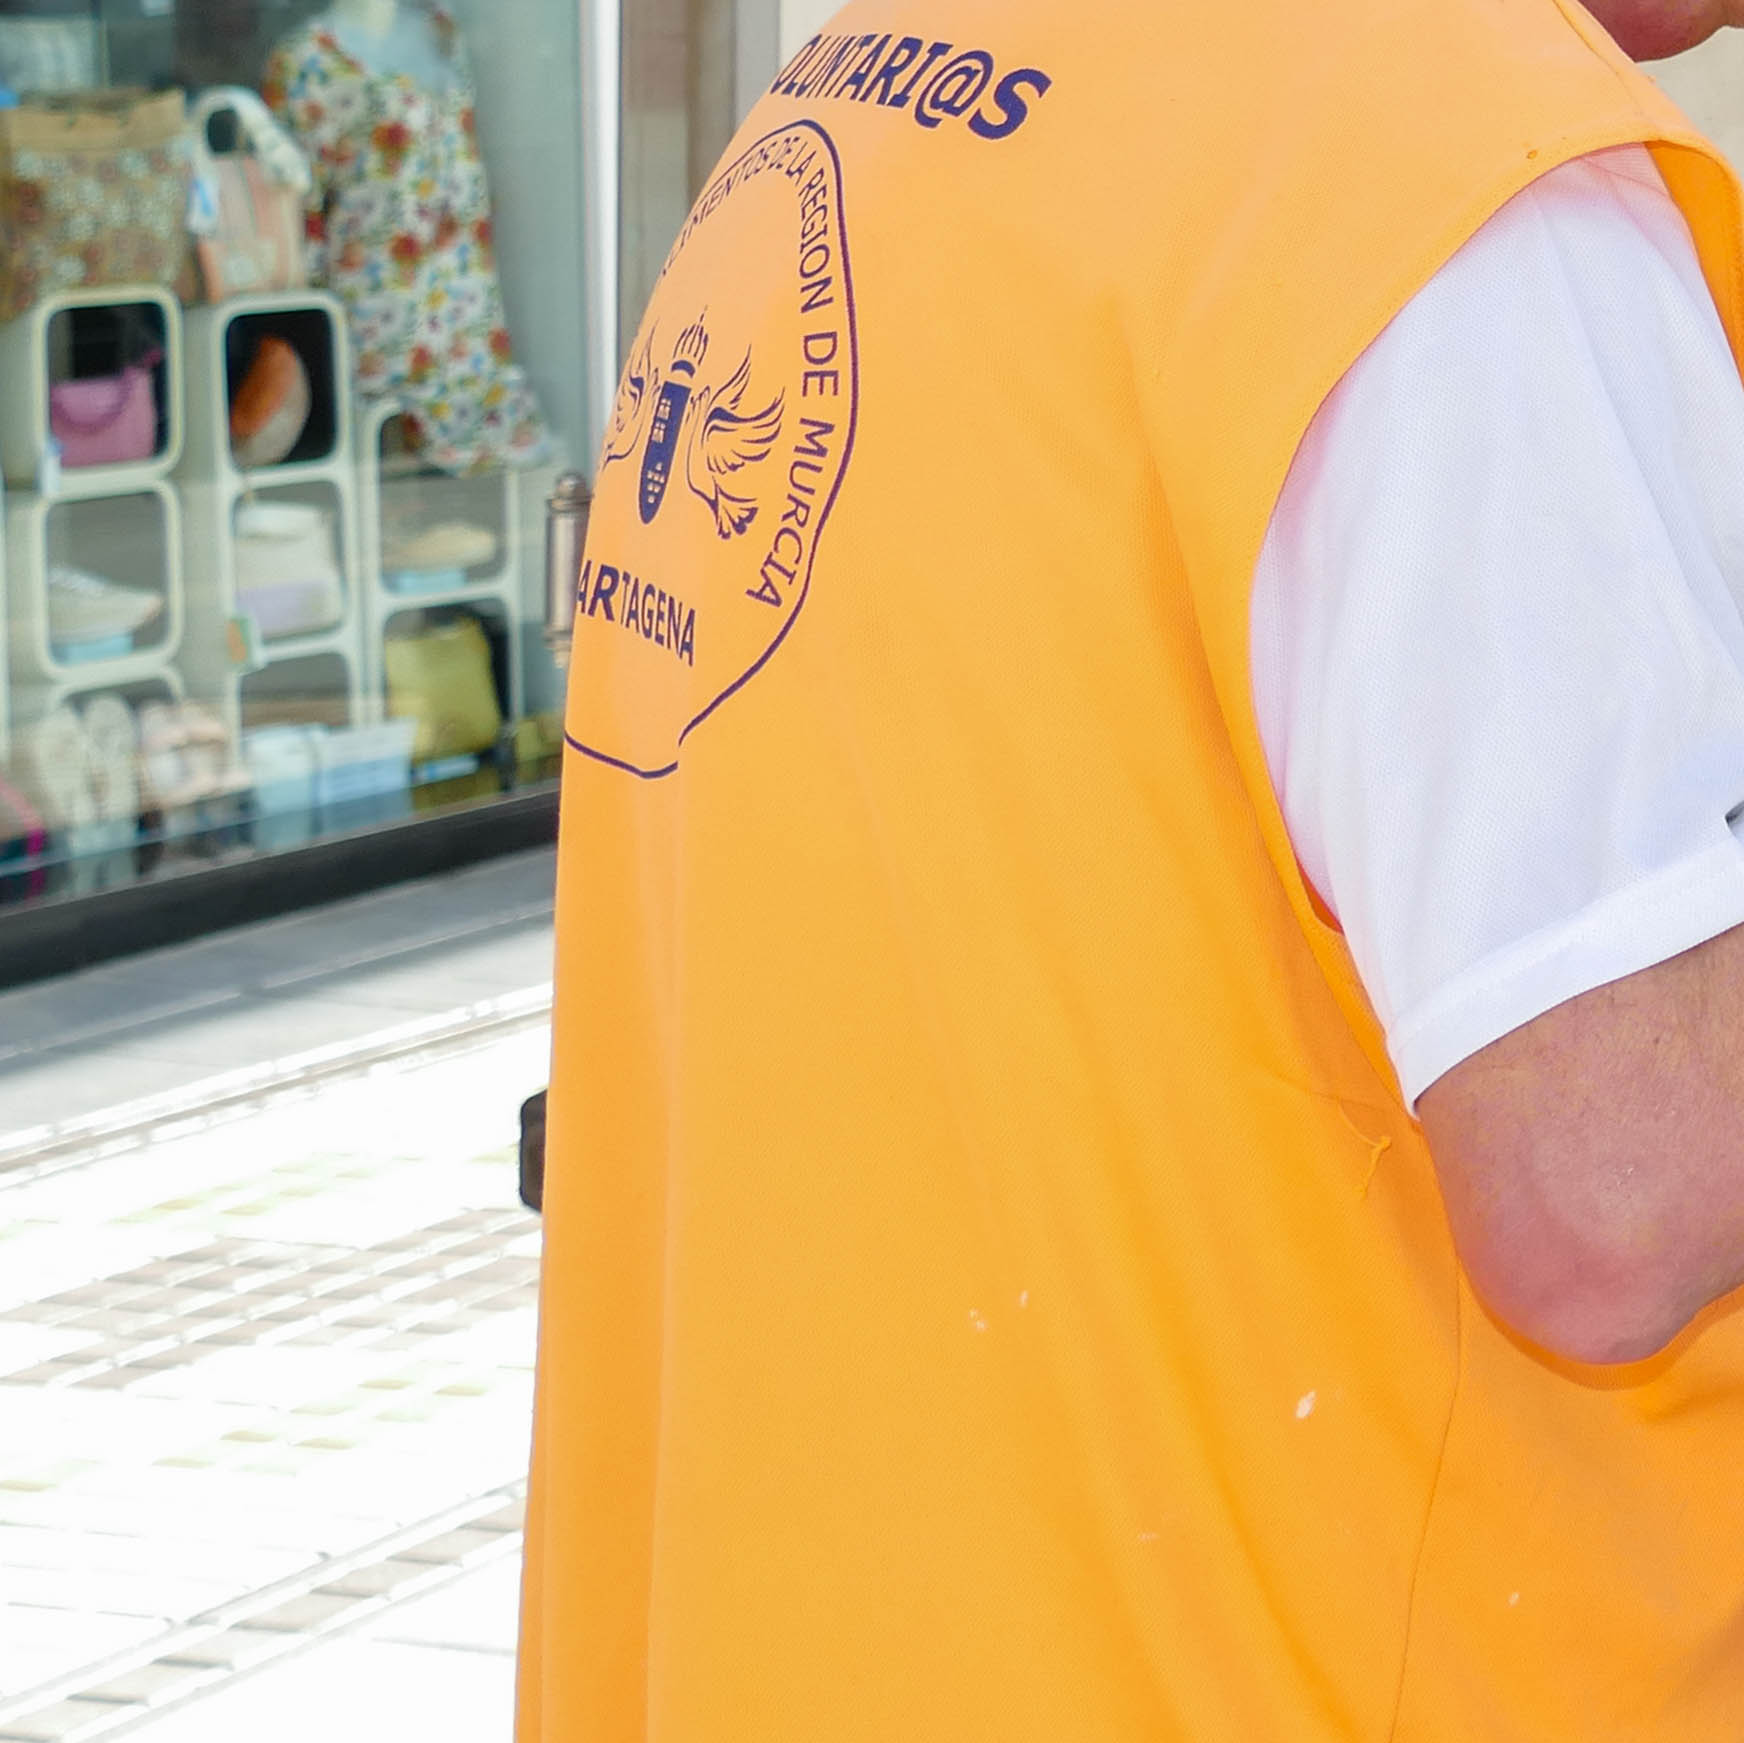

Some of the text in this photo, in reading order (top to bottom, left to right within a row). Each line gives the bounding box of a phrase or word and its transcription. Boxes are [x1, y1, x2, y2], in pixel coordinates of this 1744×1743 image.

[771, 33, 1053, 140] OLUNTARI@S
[772, 135, 800, 170] DE
[784, 140, 817, 187] LA
[798, 167, 834, 314] REGION
[801, 330, 839, 398] DE
[744, 417, 836, 609] MURCIA
[575, 559, 696, 667] ARTAGENA
